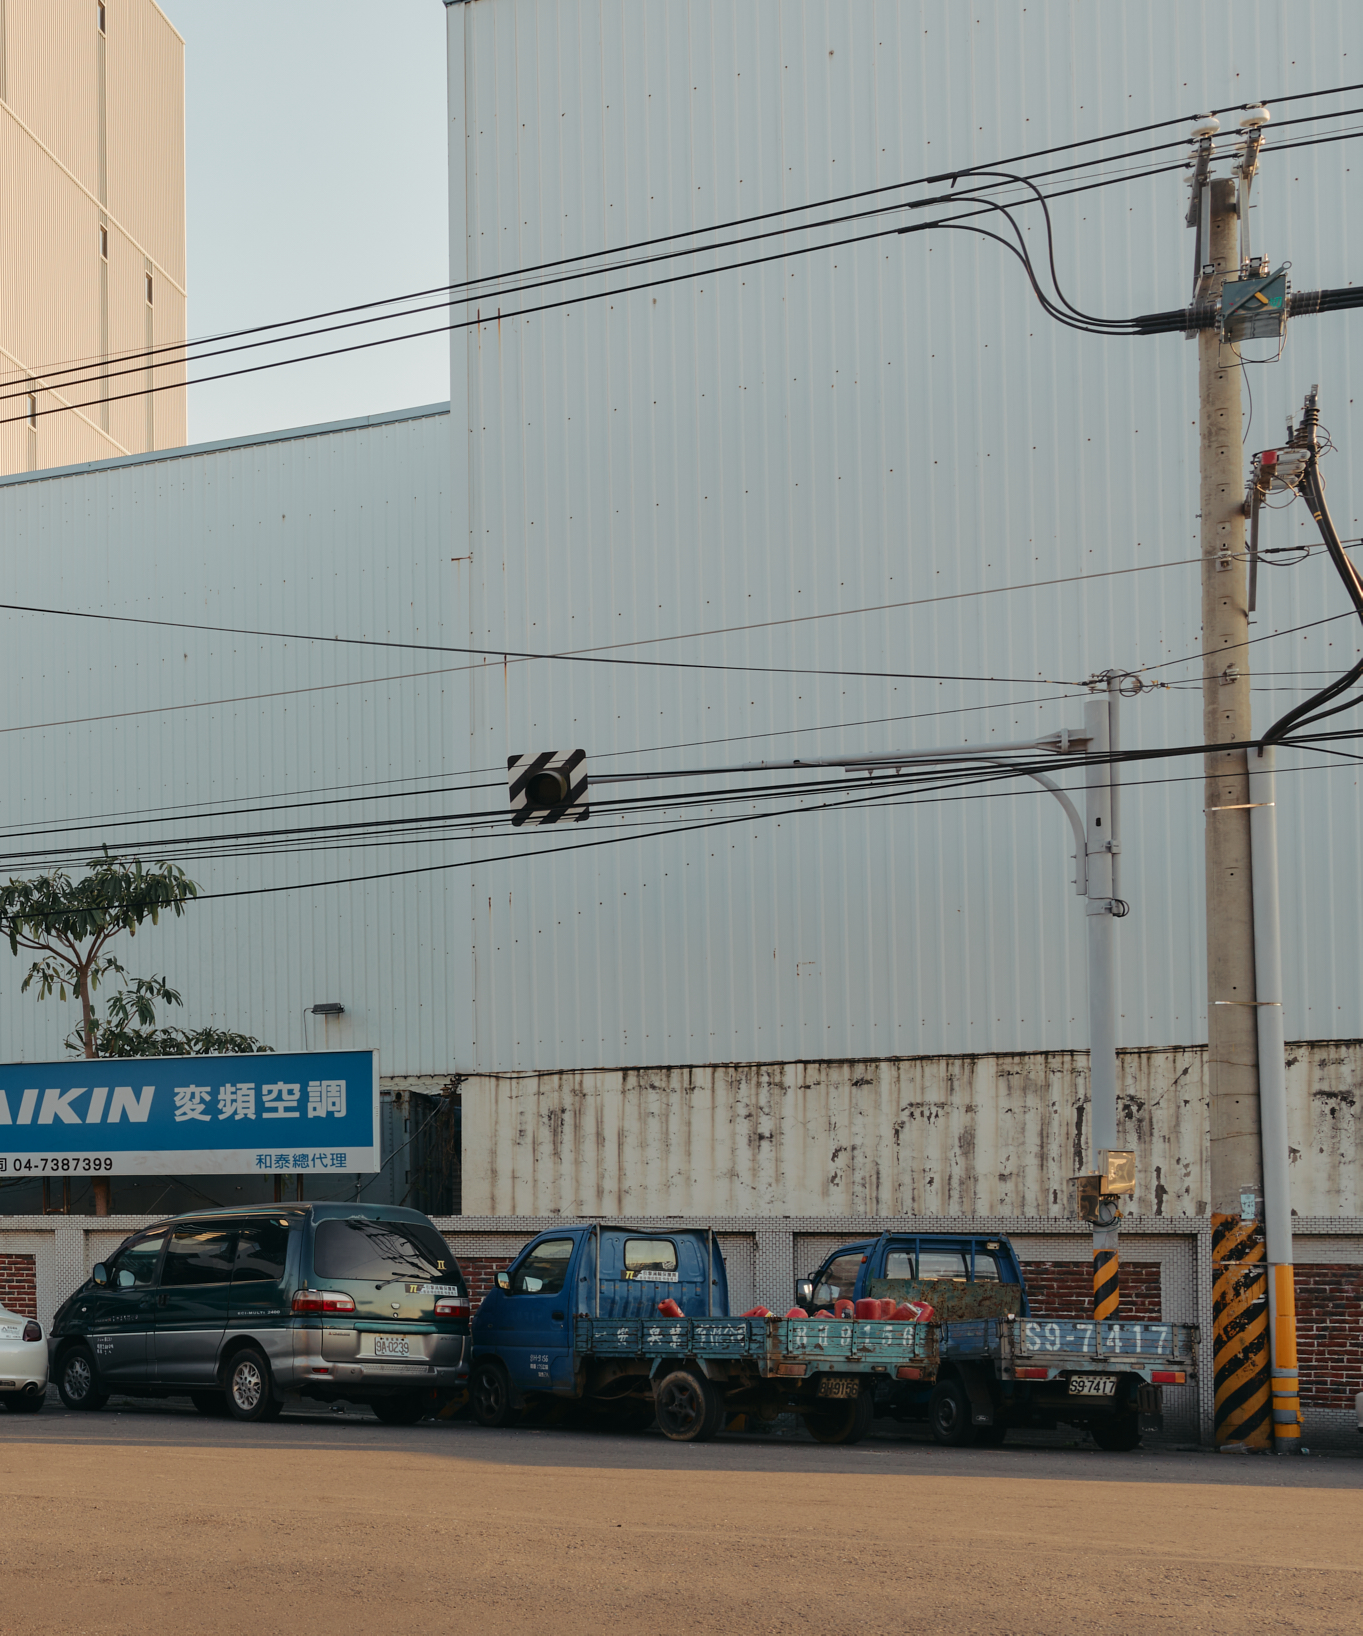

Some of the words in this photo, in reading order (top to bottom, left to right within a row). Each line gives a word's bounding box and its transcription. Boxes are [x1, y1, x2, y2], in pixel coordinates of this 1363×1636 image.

[13, 1157, 113, 1172] 04-7387399
[255, 1152, 348, 1169] 和泰總代理
[1026, 1323, 1168, 1355] S9-7417
[376, 1341, 409, 1354] 9A-0239
[1069, 1380, 1116, 1394] S9-7417
